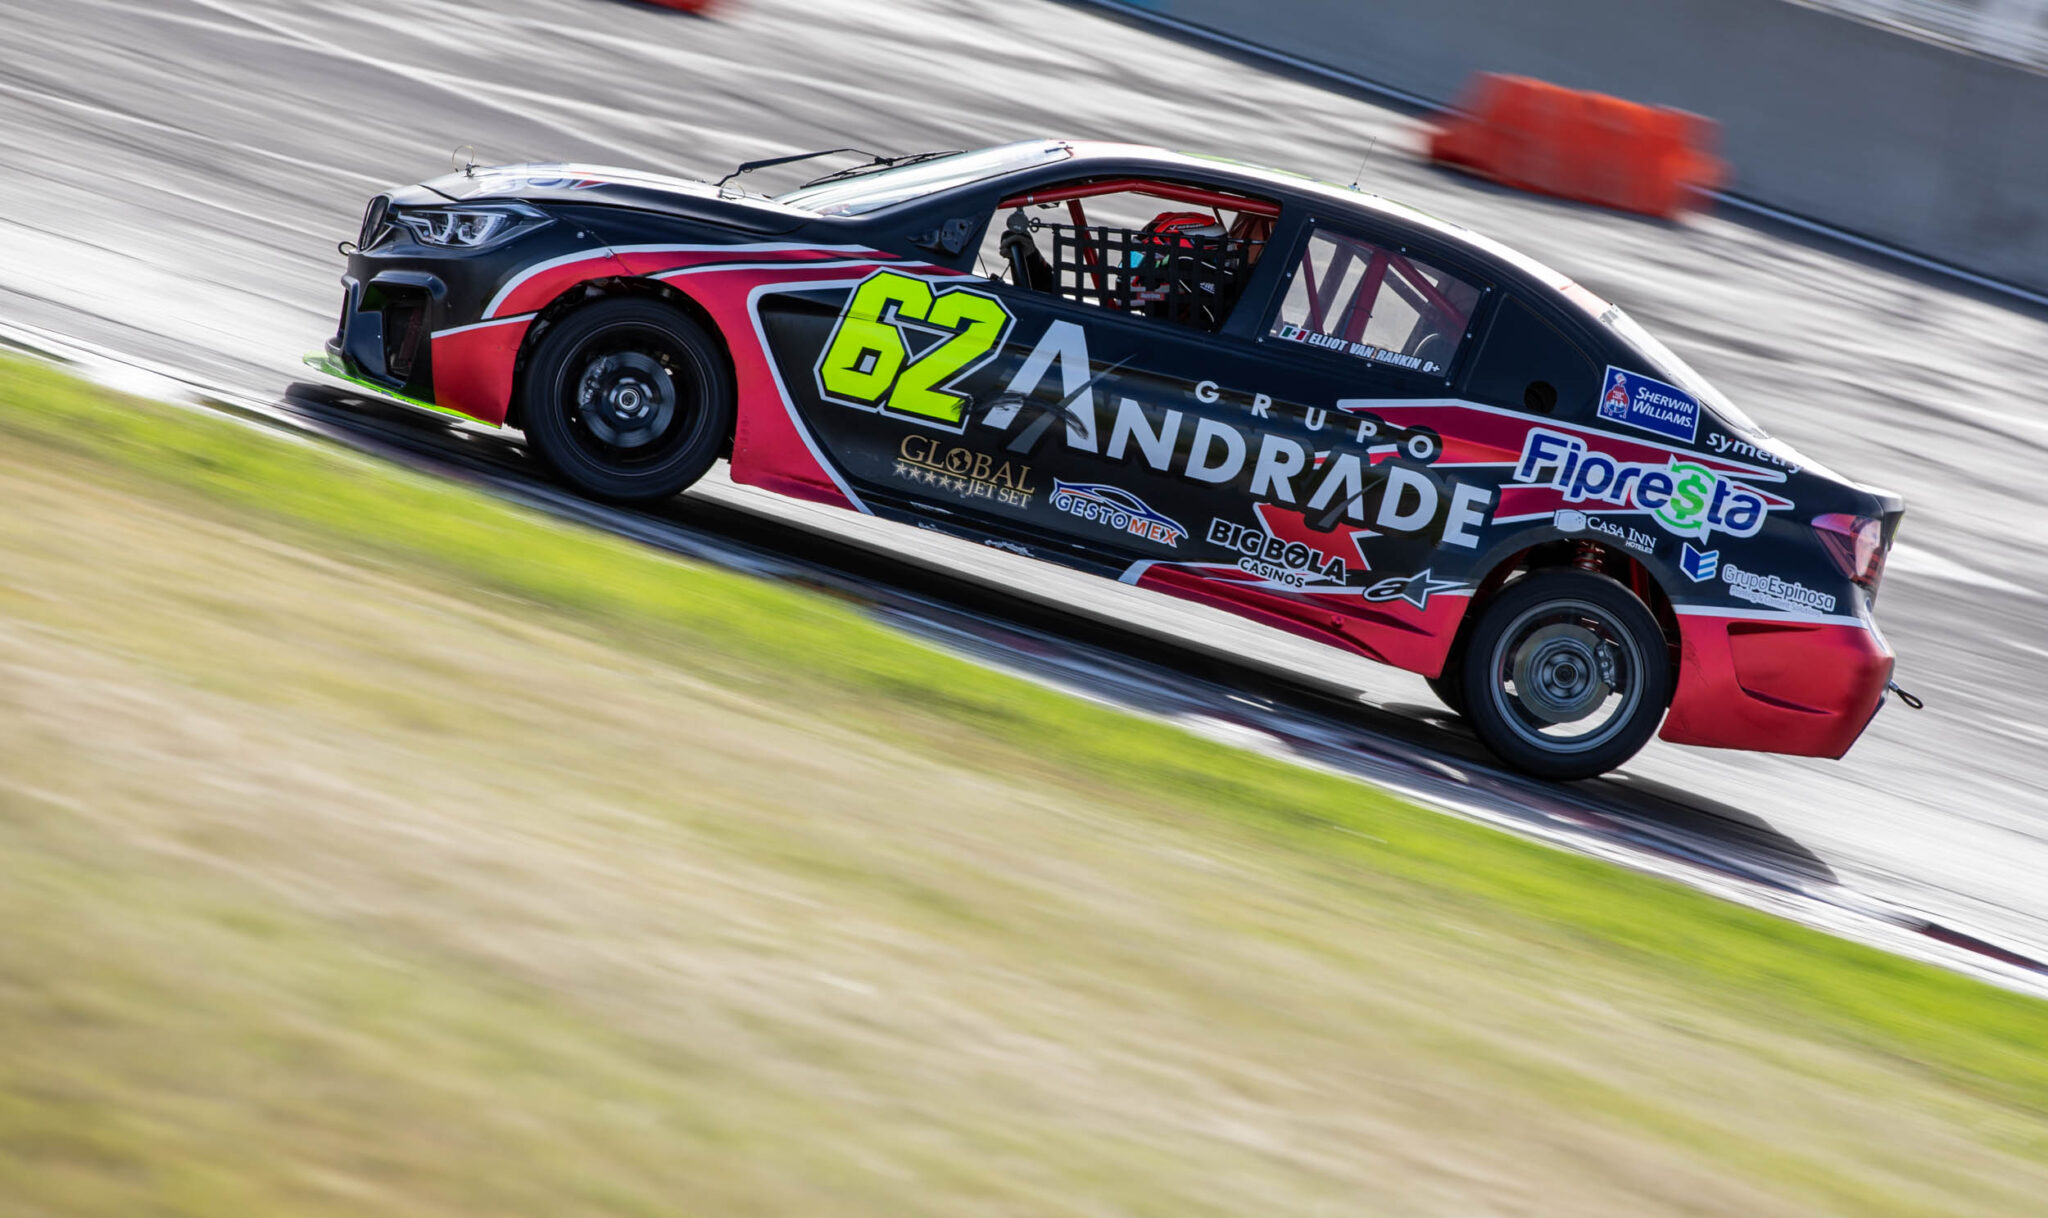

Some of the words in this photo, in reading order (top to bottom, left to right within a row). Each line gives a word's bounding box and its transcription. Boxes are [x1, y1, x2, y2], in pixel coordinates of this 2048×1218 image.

[816, 269, 1013, 432] 62
[1308, 333, 1348, 351] ELLIOT
[1350, 343, 1374, 358] VAN
[1375, 349, 1422, 369] RANKIN
[1636, 386, 1694, 414] SHERWIN
[982, 318, 1493, 550] ANDRADE
[1194, 380, 1434, 460] GRUPO
[900, 434, 1035, 494] GLOBAL
[966, 478, 998, 499] JET
[998, 487, 1031, 508] SET
[1056, 494, 1178, 547] GESTOMEX
[1587, 517, 1625, 538] CASA
[1627, 527, 1657, 548] INN
[1625, 540, 1653, 554] HOTELES
[1240, 558, 1304, 588] CASINOS
